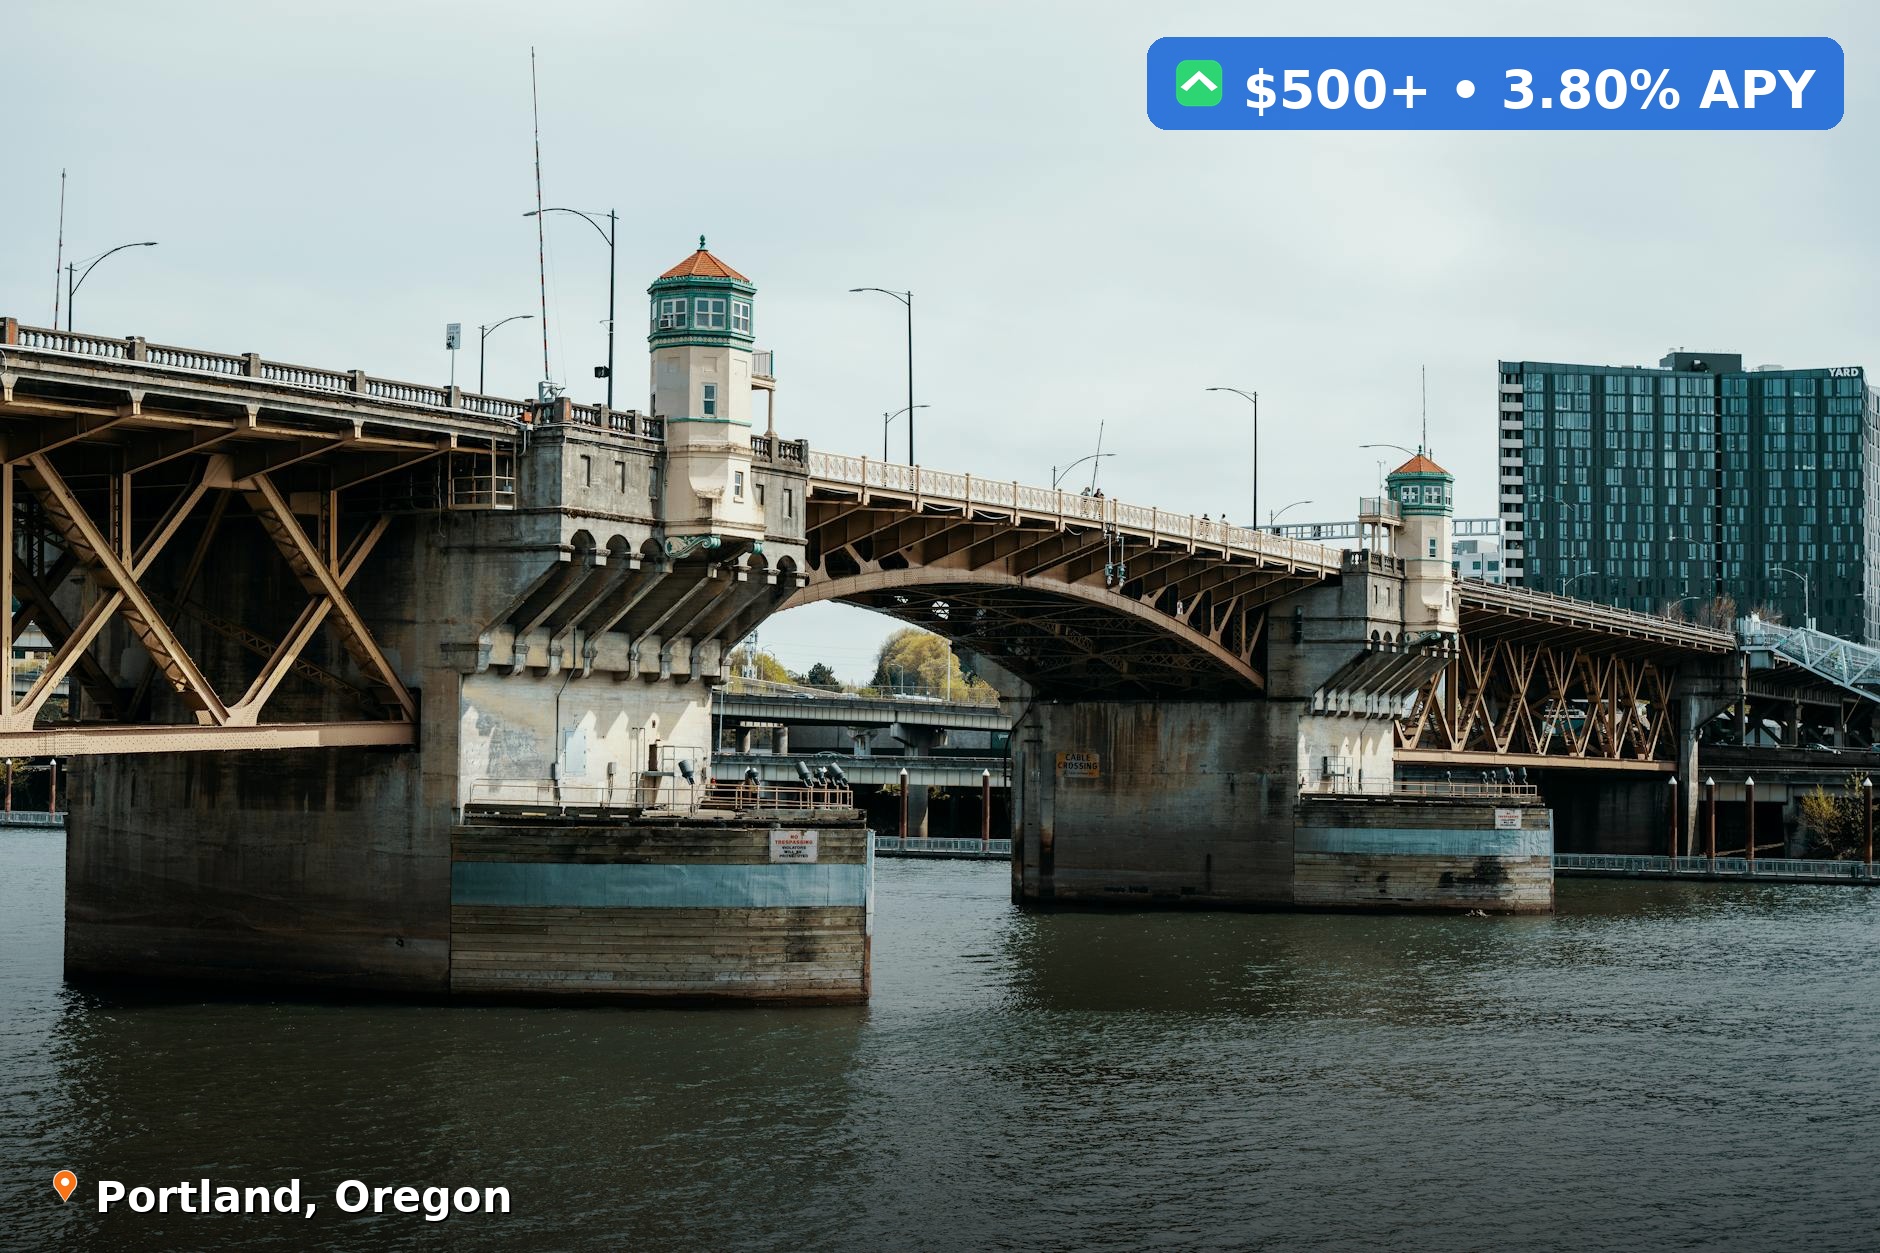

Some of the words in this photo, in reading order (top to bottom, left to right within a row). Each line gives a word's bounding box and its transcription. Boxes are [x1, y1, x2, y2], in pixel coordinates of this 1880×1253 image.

[1828, 368, 1859, 377] YARD
[1065, 753, 1090, 761] CABLE
[1057, 762, 1098, 770] CROSSING
